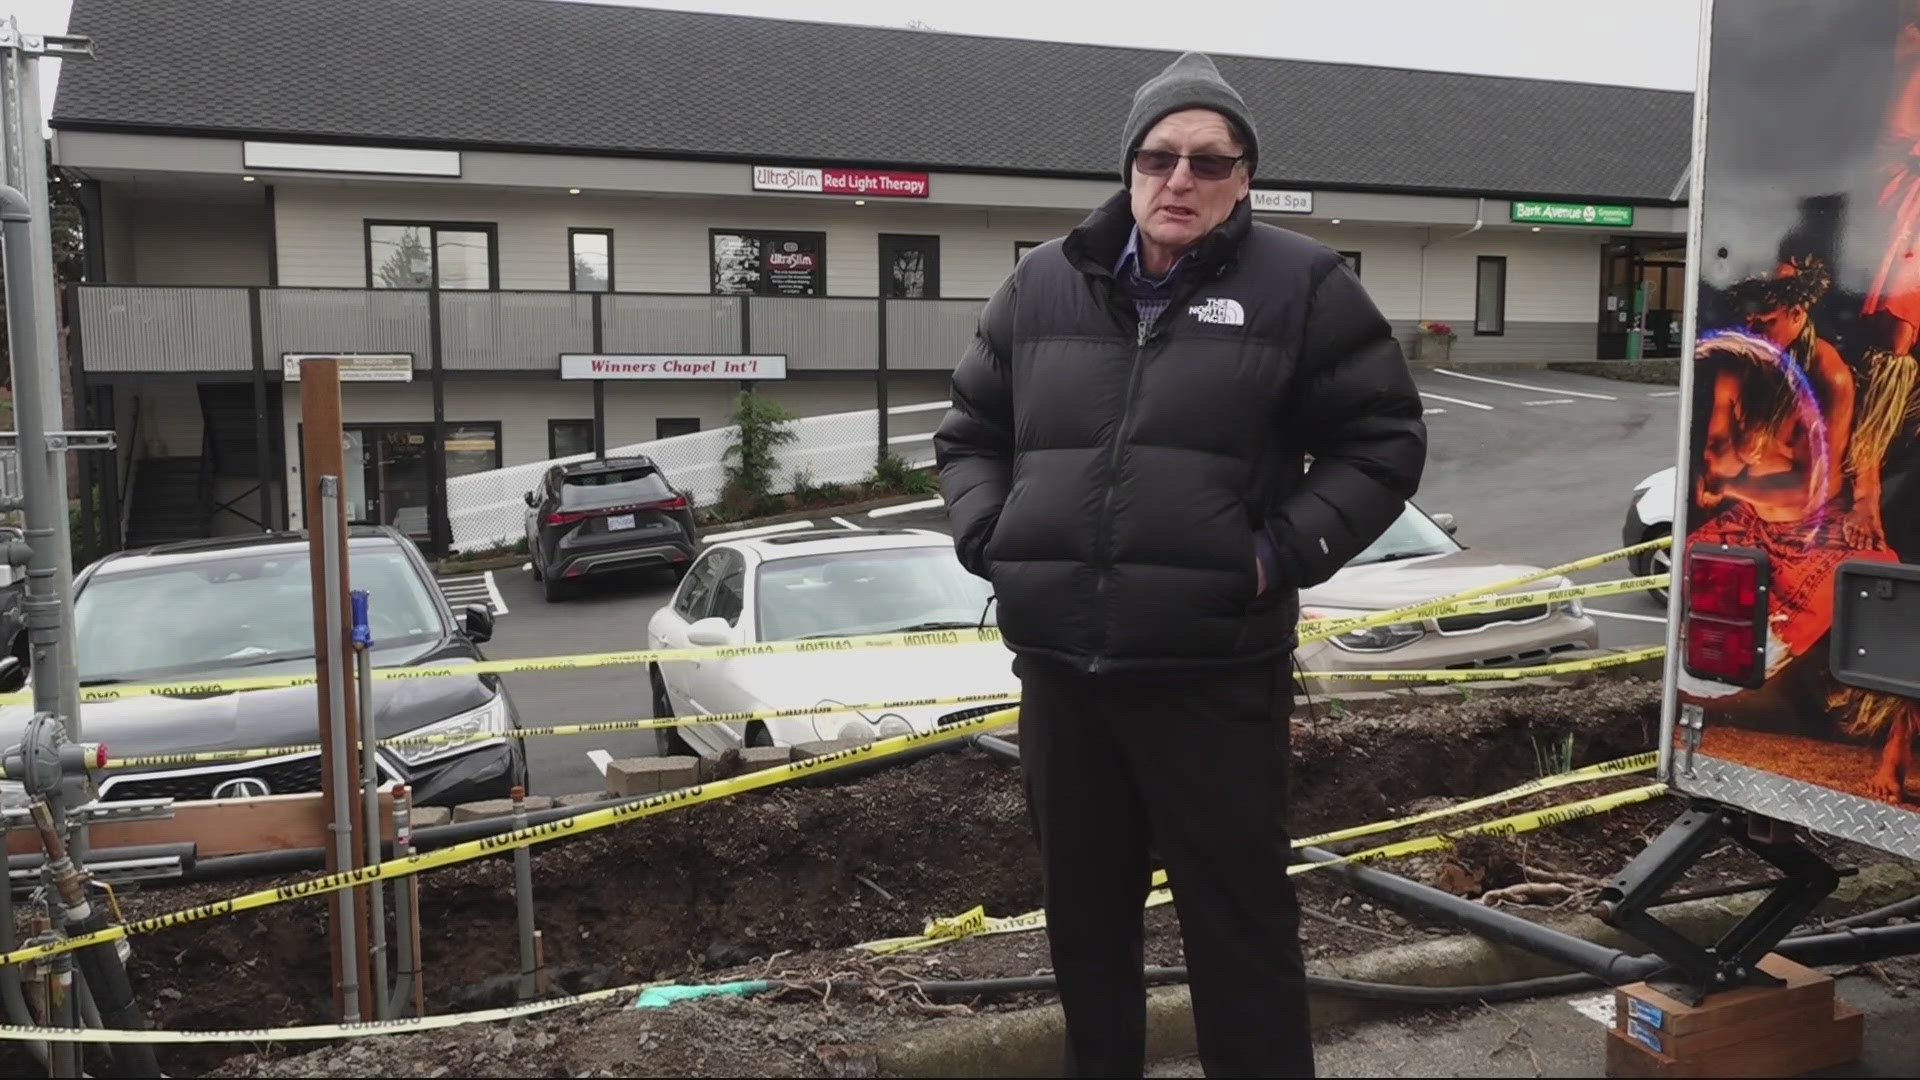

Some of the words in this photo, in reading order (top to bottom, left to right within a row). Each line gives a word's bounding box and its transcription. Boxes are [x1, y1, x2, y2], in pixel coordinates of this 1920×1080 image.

[757, 169, 818, 189] UltraSlim
[824, 174, 846, 188] Red
[848, 175, 878, 192] Light
[879, 176, 926, 194] Therapy
[1255, 194, 1280, 206] Med
[1284, 195, 1307, 208] Spa
[1516, 203, 1542, 218] Bark
[1542, 205, 1582, 219] Avenue
[770, 253, 812, 268] UltraSlim
[591, 360, 657, 373] Winners
[663, 359, 716, 376] Chapel
[723, 360, 758, 373] Int'l
[1599, 752, 1659, 775] CAUTION
[1537, 803, 1596, 830] CAUTION
[275, 864, 382, 900] CAUTION
